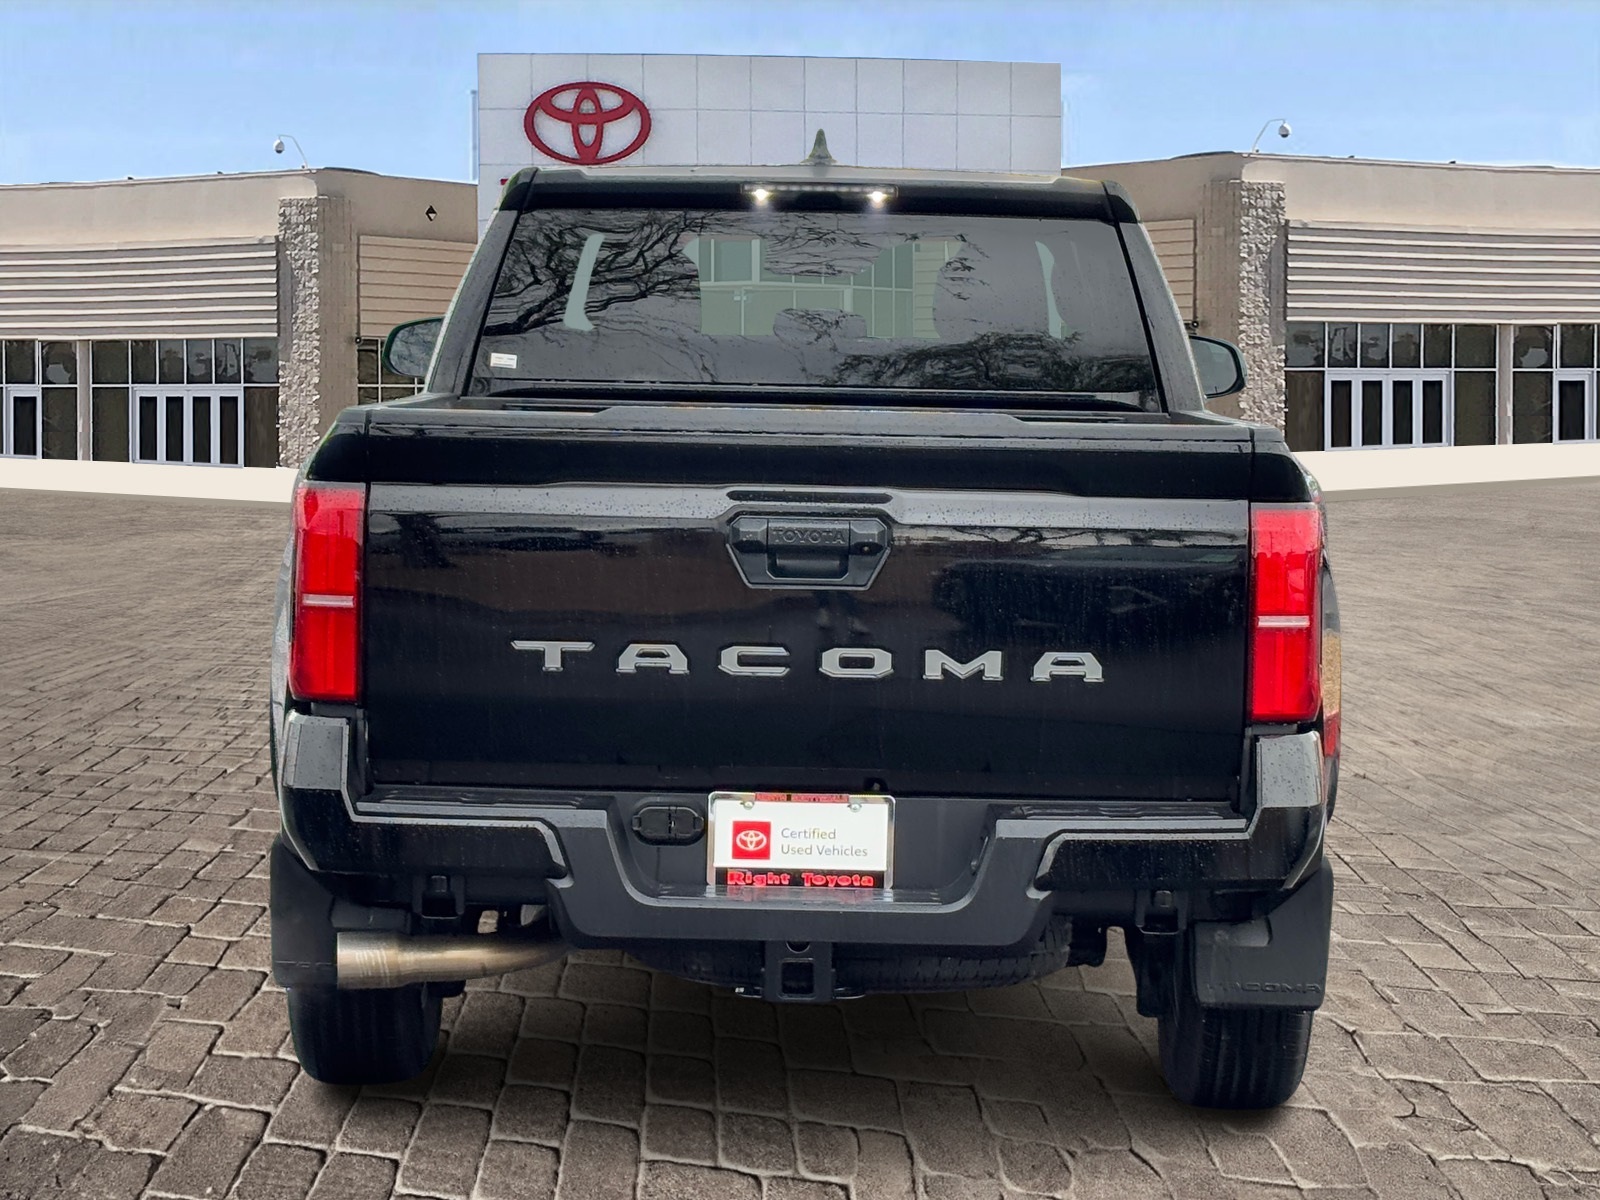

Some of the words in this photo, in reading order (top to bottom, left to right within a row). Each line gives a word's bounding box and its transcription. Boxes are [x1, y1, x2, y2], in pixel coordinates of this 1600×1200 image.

[771, 528, 845, 544] TOYOTA
[510, 640, 1104, 682] TACOMA
[781, 827, 837, 840] Certified
[781, 844, 813, 855] Used
[816, 844, 868, 857] Vehicles
[727, 870, 790, 887] Right
[801, 872, 873, 888] Toyota
[1206, 981, 1321, 994] COMA
